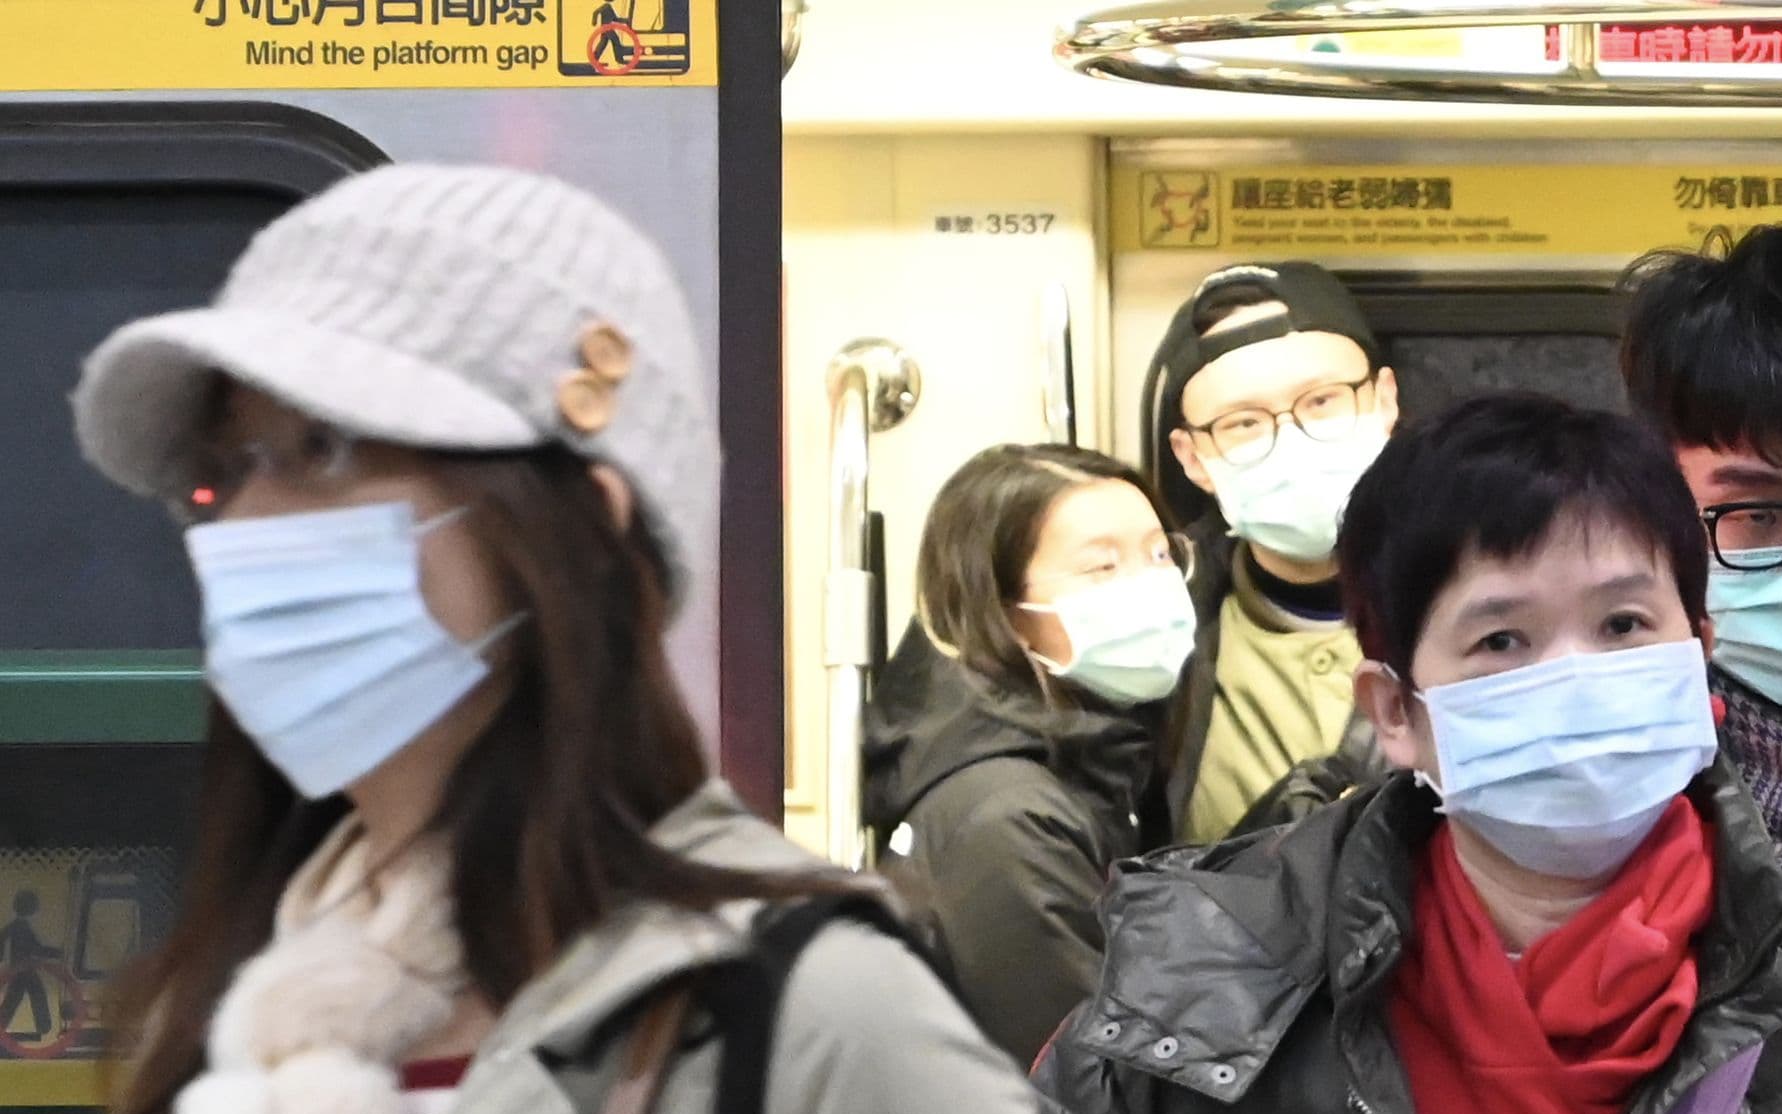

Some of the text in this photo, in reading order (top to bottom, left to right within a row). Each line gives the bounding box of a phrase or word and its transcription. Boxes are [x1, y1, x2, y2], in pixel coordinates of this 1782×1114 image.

[245, 40, 548, 71] Mind the platform gap
[986, 213, 1055, 234] 3537
